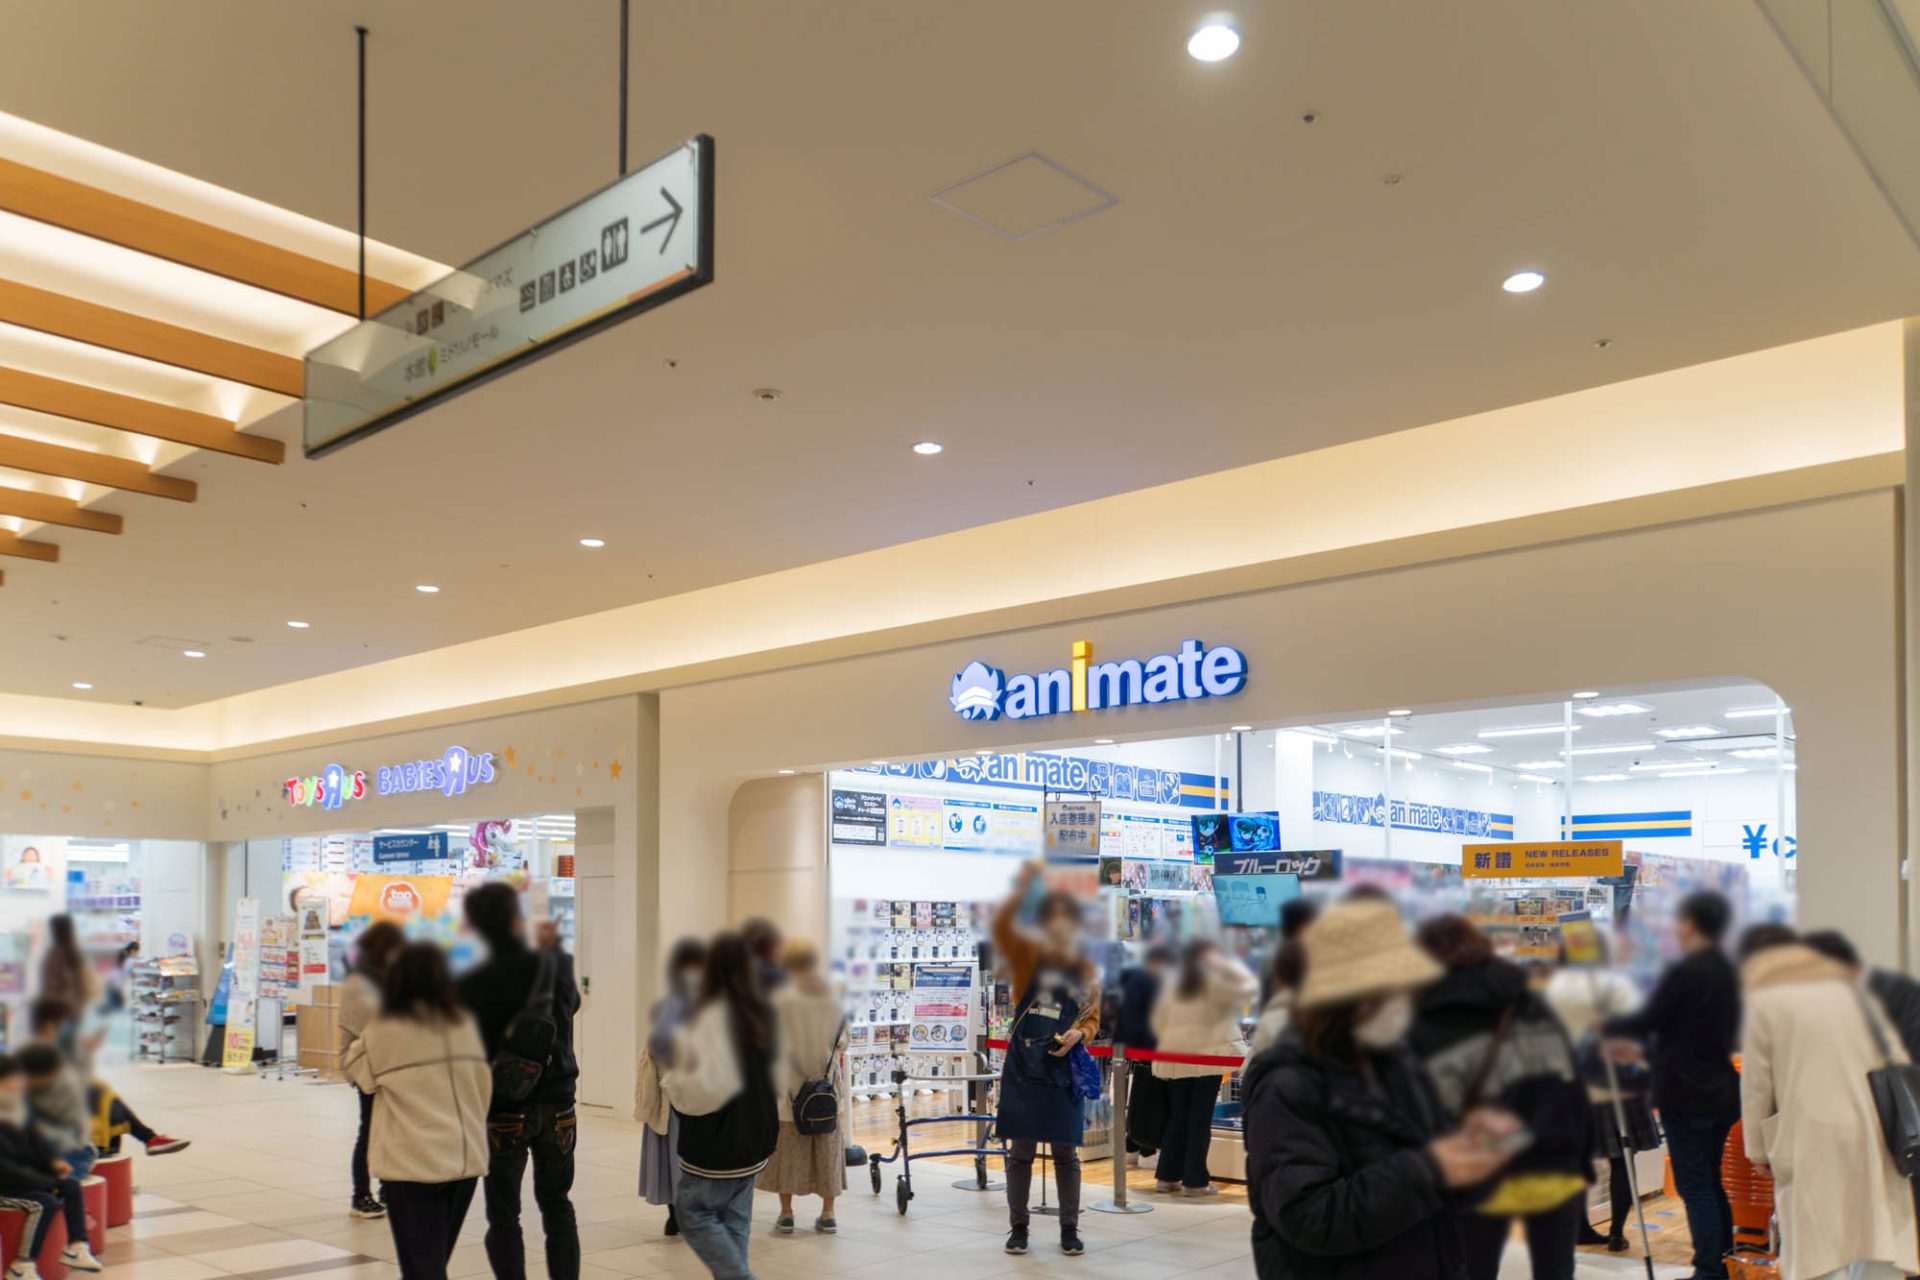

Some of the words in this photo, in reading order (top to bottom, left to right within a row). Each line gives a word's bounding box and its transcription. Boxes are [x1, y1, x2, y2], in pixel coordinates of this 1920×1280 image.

[1004, 639, 1248, 720] animate
[987, 752, 1084, 790] animate
[1050, 812, 1096, 825] 入店整理券
[1525, 850, 1548, 859] NEW
[1552, 847, 1609, 858] RELEASES
[1233, 856, 1322, 876] ブルーロック
